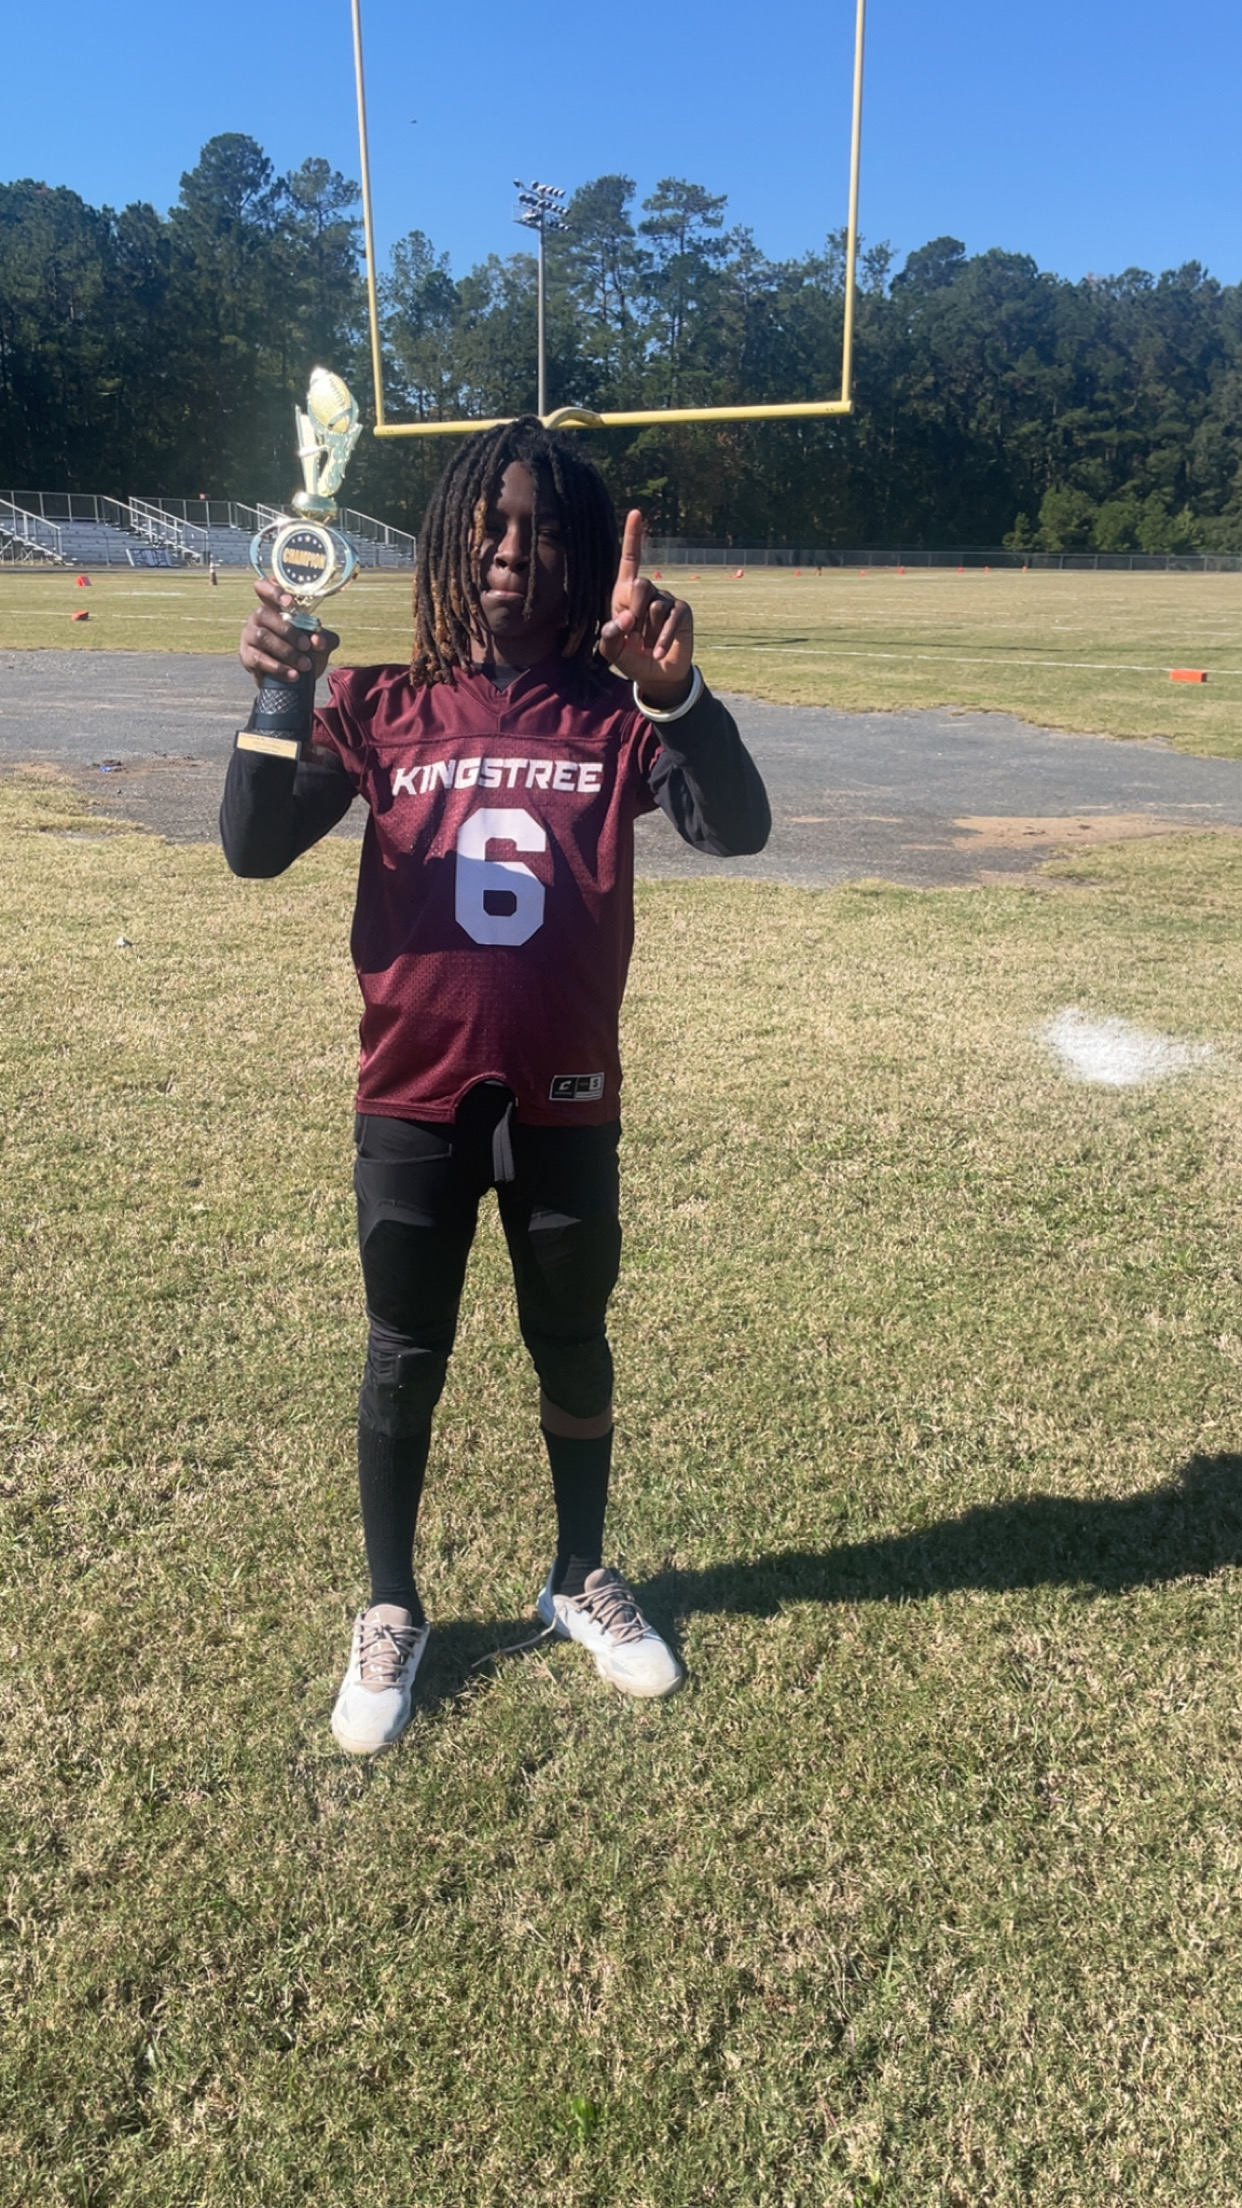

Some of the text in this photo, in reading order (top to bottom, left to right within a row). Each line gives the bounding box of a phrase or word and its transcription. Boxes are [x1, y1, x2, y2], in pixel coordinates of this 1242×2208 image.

[282, 547, 326, 569] CHAMPION
[391, 758, 604, 797] KINGSTREE
[455, 808, 546, 946] 6
